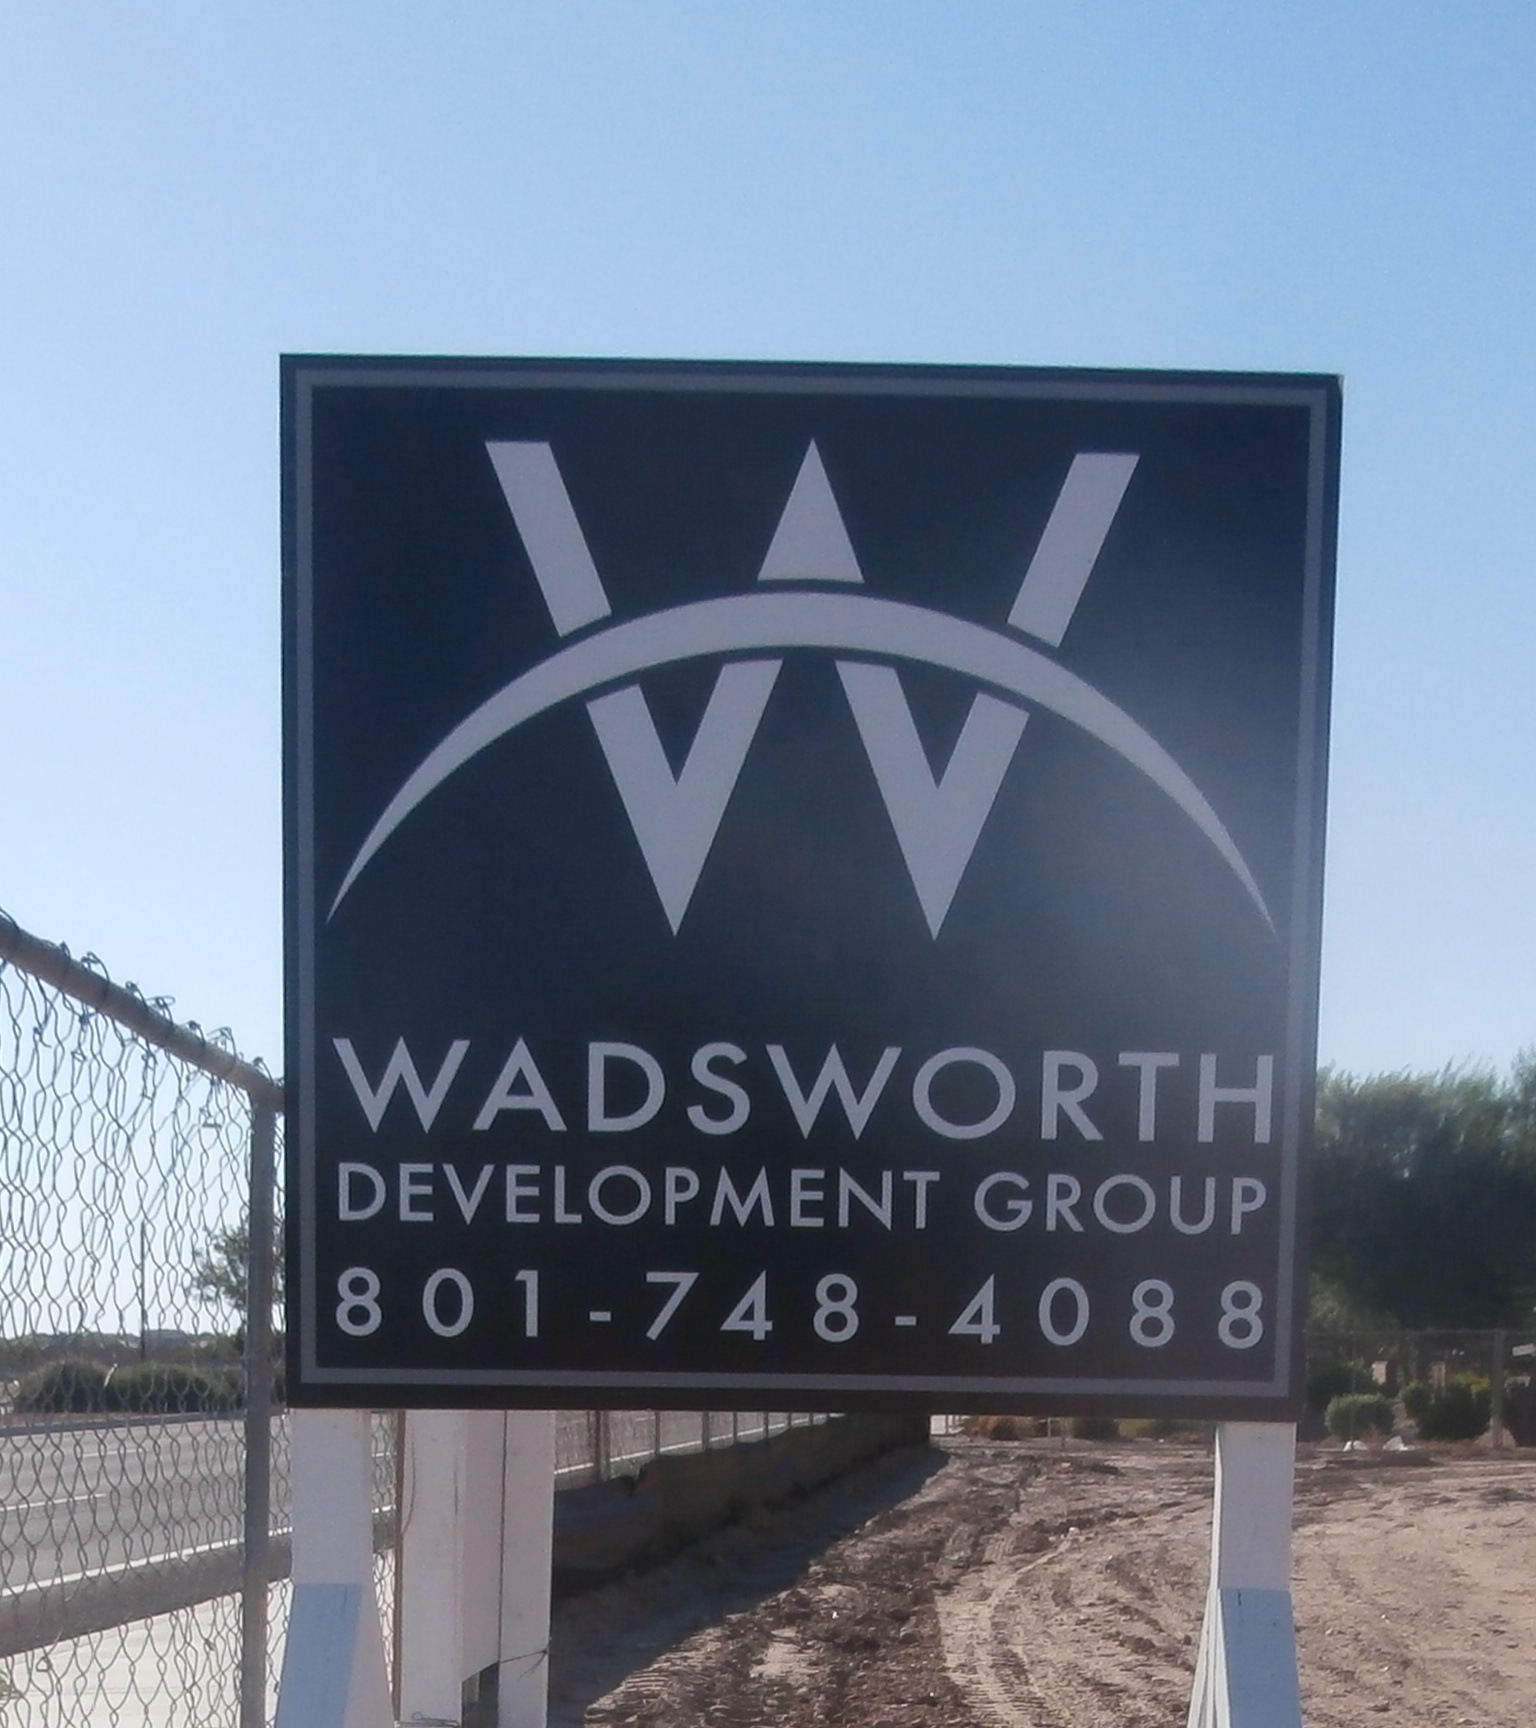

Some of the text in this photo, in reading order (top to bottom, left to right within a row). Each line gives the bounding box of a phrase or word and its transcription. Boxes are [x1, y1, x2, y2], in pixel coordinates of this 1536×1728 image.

[332, 1036, 1274, 1144] WADSWORTH
[337, 1162, 1268, 1234] DEVELOPMENT GROUP
[334, 1266, 1265, 1349] 801-748-4088
